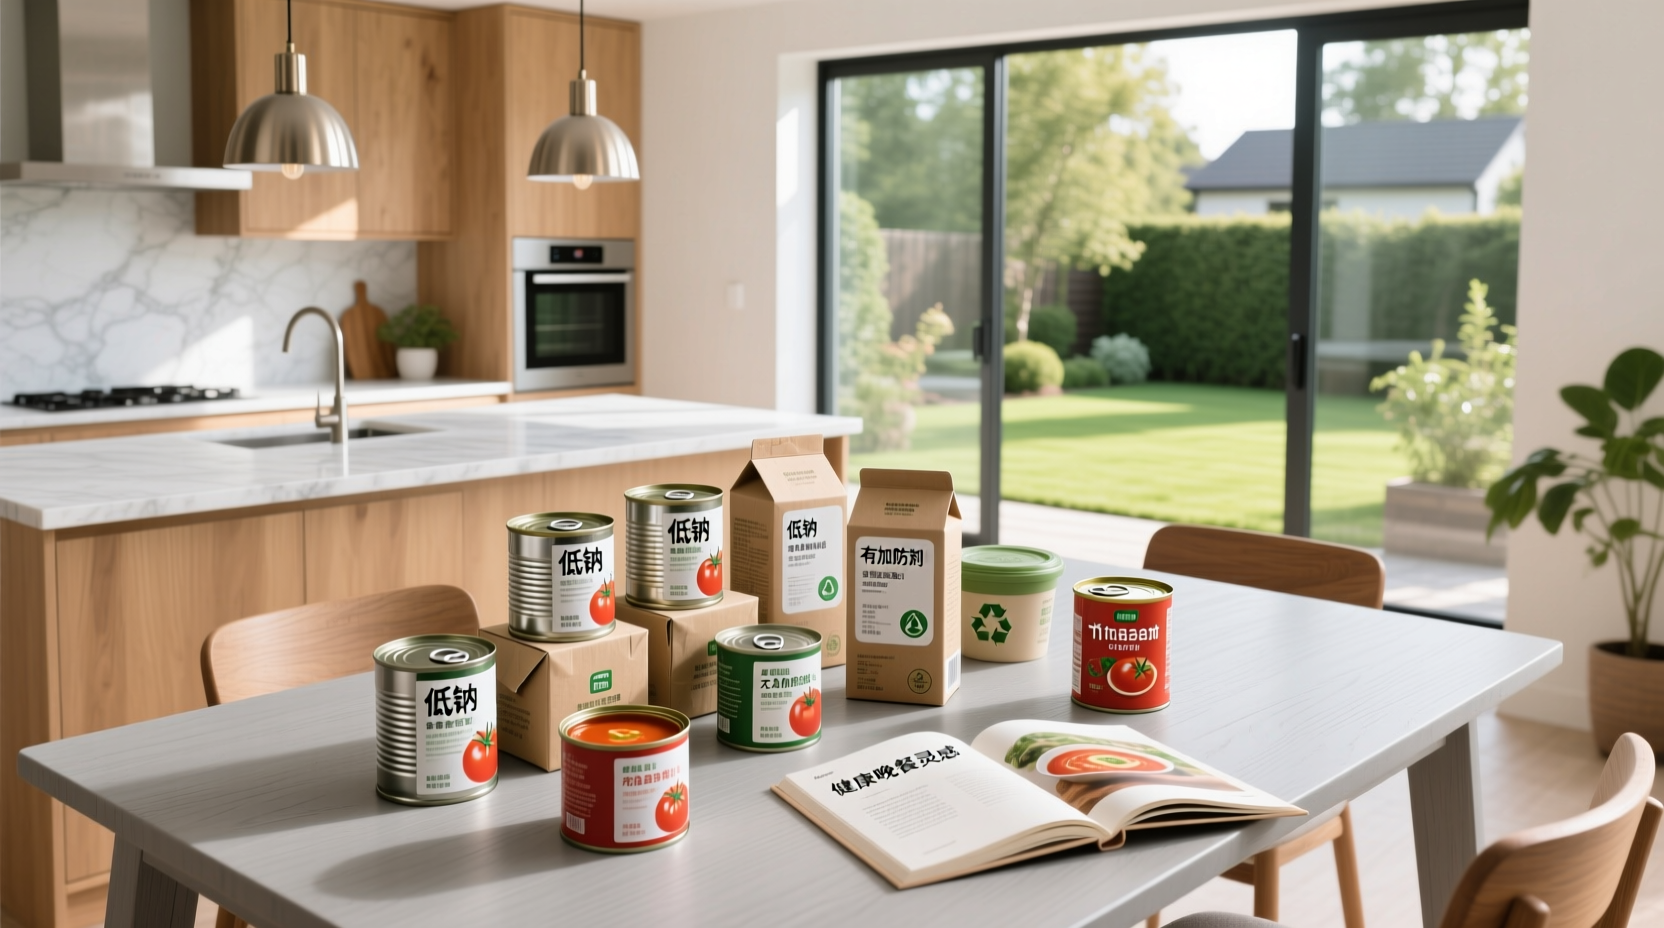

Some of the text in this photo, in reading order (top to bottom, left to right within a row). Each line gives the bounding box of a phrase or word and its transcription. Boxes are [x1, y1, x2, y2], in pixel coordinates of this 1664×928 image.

[667, 516, 710, 544] 低钠
[558, 547, 603, 576] 低钠
[424, 683, 478, 717] 低钠
[831, 745, 960, 796] 健康晚餐灵感
